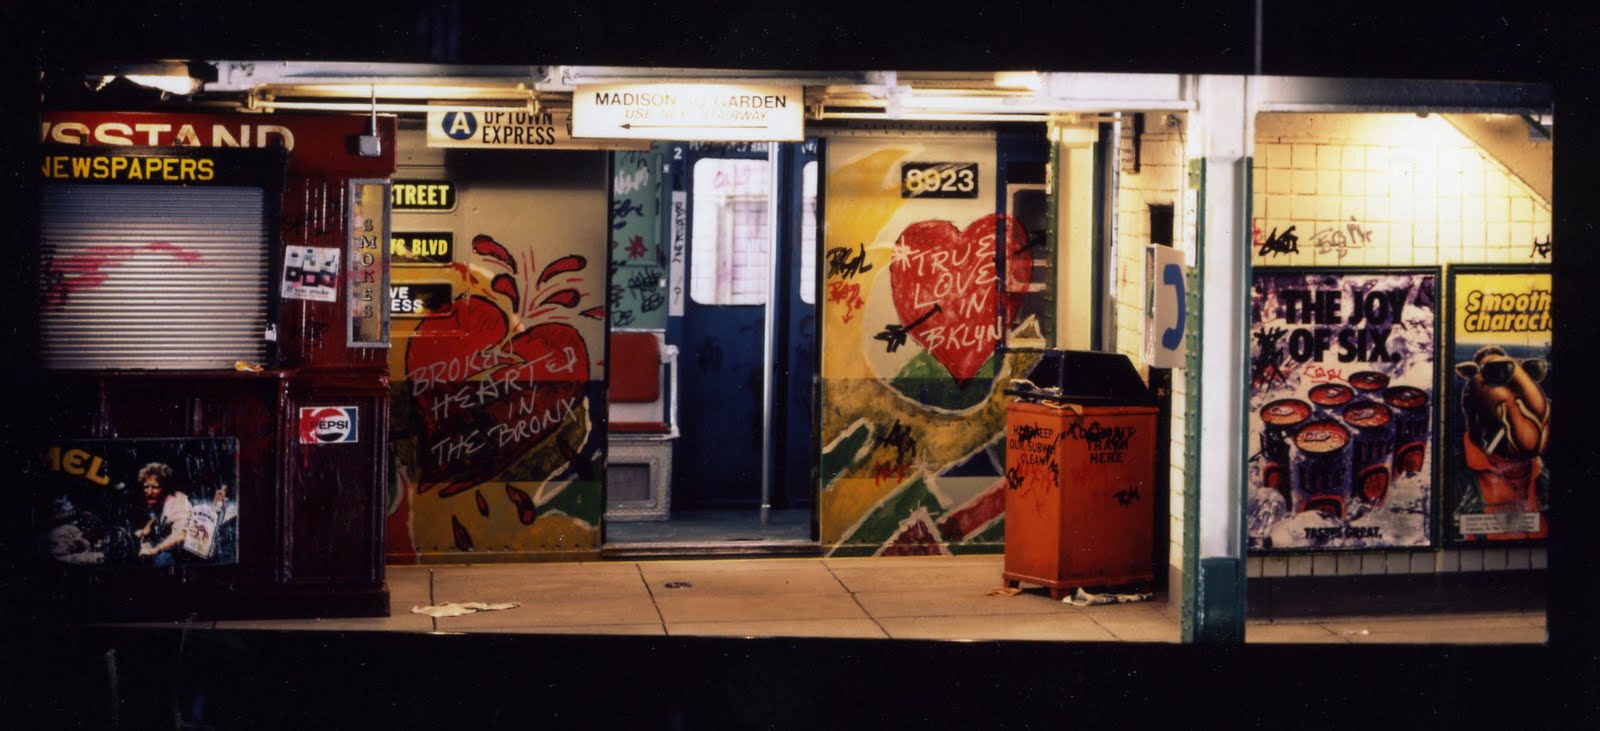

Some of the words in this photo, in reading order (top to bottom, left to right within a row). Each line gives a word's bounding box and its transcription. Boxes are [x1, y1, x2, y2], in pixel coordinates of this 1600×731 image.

[594, 92, 676, 107] MADISON
[449, 112, 471, 135] A
[482, 125, 556, 145] EXPRESS
[673, 147, 683, 159] 2
[905, 169, 975, 192] 8923
[412, 239, 449, 256] BLVD
[911, 234, 997, 277] TRUE
[360, 218, 377, 318] SMOKES
[914, 257, 1000, 309] LOVE
[960, 286, 991, 319] IN
[1280, 290, 1342, 325] THE
[1348, 290, 1406, 325] JOY
[1465, 290, 1552, 313] Smooth
[919, 315, 1003, 355] BKLYN
[1464, 311, 1552, 332] charact
[1289, 328, 1332, 363] OF
[1337, 328, 1401, 364] SIX.
[406, 338, 514, 396] BROKEN
[431, 346, 578, 421] HEARTED
[508, 385, 537, 419] IN
[309, 420, 349, 430] PEPSI
[431, 429, 486, 465] THE
[487, 396, 578, 448] BRONX
[1090, 451, 1124, 464] HERE
